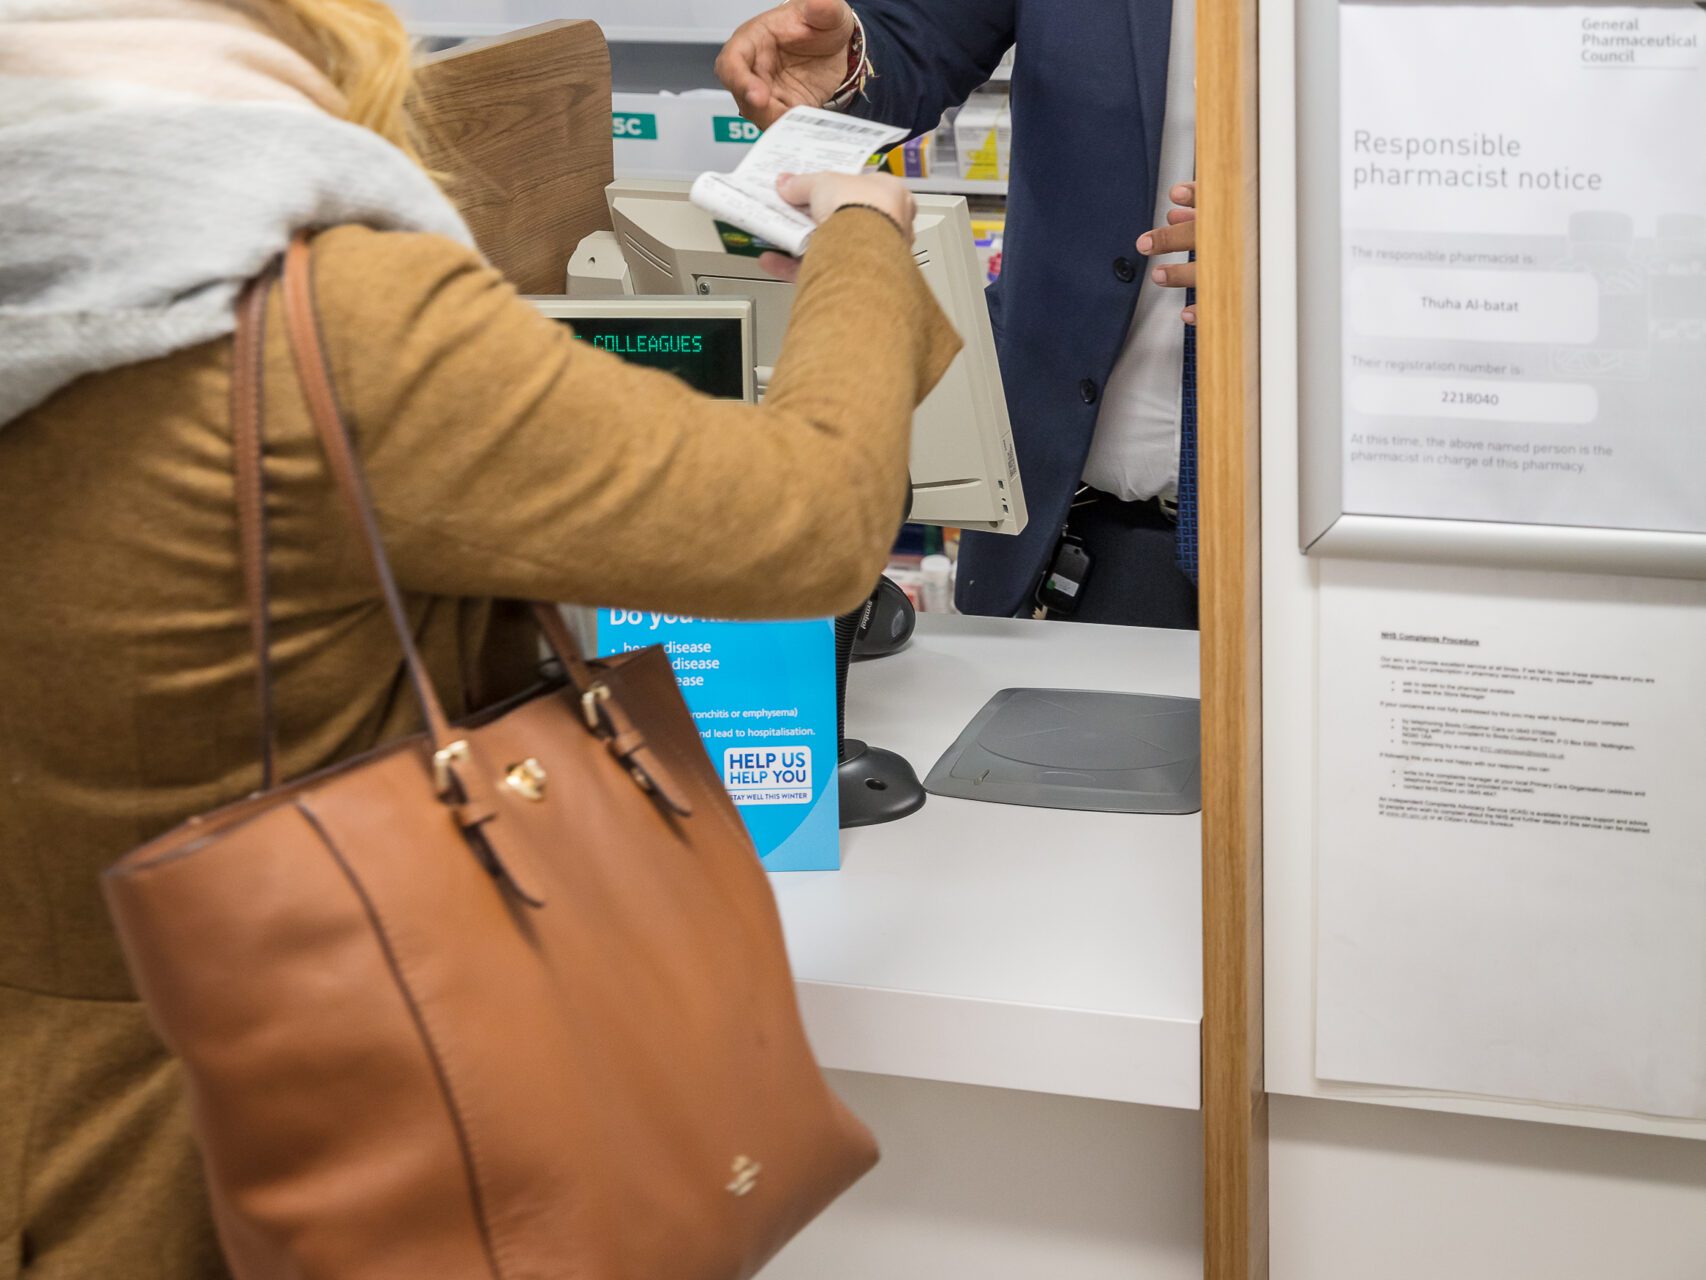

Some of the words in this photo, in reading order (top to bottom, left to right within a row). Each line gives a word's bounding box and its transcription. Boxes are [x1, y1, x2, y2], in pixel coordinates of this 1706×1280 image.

[1581, 18, 1639, 31] General
[1582, 33, 1697, 47] Pharmaceutical
[1581, 48, 1635, 62] Council
[613, 118, 643, 137] 5C
[728, 121, 760, 140] 5D
[1354, 129, 1521, 160] Responsible
[1354, 162, 1508, 190] pharmacist
[1519, 166, 1602, 191] notice
[1352, 245, 1372, 258] The
[1375, 249, 1446, 262] responsible
[1449, 251, 1519, 265] pharmacist
[1421, 295, 1462, 310] Thuha
[1465, 298, 1520, 312] Al-batat
[594, 335, 702, 352] COLLEAGUES
[1352, 355, 1382, 368] Their
[1385, 359, 1455, 373] registration
[1459, 362, 1507, 375] number
[1441, 391, 1499, 405] 2218040
[1351, 433, 1363, 445] At
[1366, 434, 1389, 446] this
[1426, 436, 1445, 448] the
[1449, 436, 1484, 450] above
[1488, 440, 1529, 453] named
[1533, 444, 1576, 456] person
[1593, 444, 1613, 456] the
[1351, 450, 1419, 463] pharmacist
[1437, 453, 1478, 469] charge
[1496, 457, 1519, 470] this
[610, 608, 643, 626] Do
[664, 641, 712, 654] disease
[672, 657, 720, 670] disease
[731, 710, 740, 718] or
[742, 707, 798, 720] emphysema)
[714, 729, 733, 738] lead
[735, 729, 746, 738] to
[747, 726, 816, 739] hospitalisation.
[730, 753, 776, 769] HELP
[782, 752, 806, 768] US
[730, 770, 768, 785] HELP
[773, 769, 806, 784] YOU
[746, 793, 764, 801] WELL
[782, 792, 807, 800] WINTER
